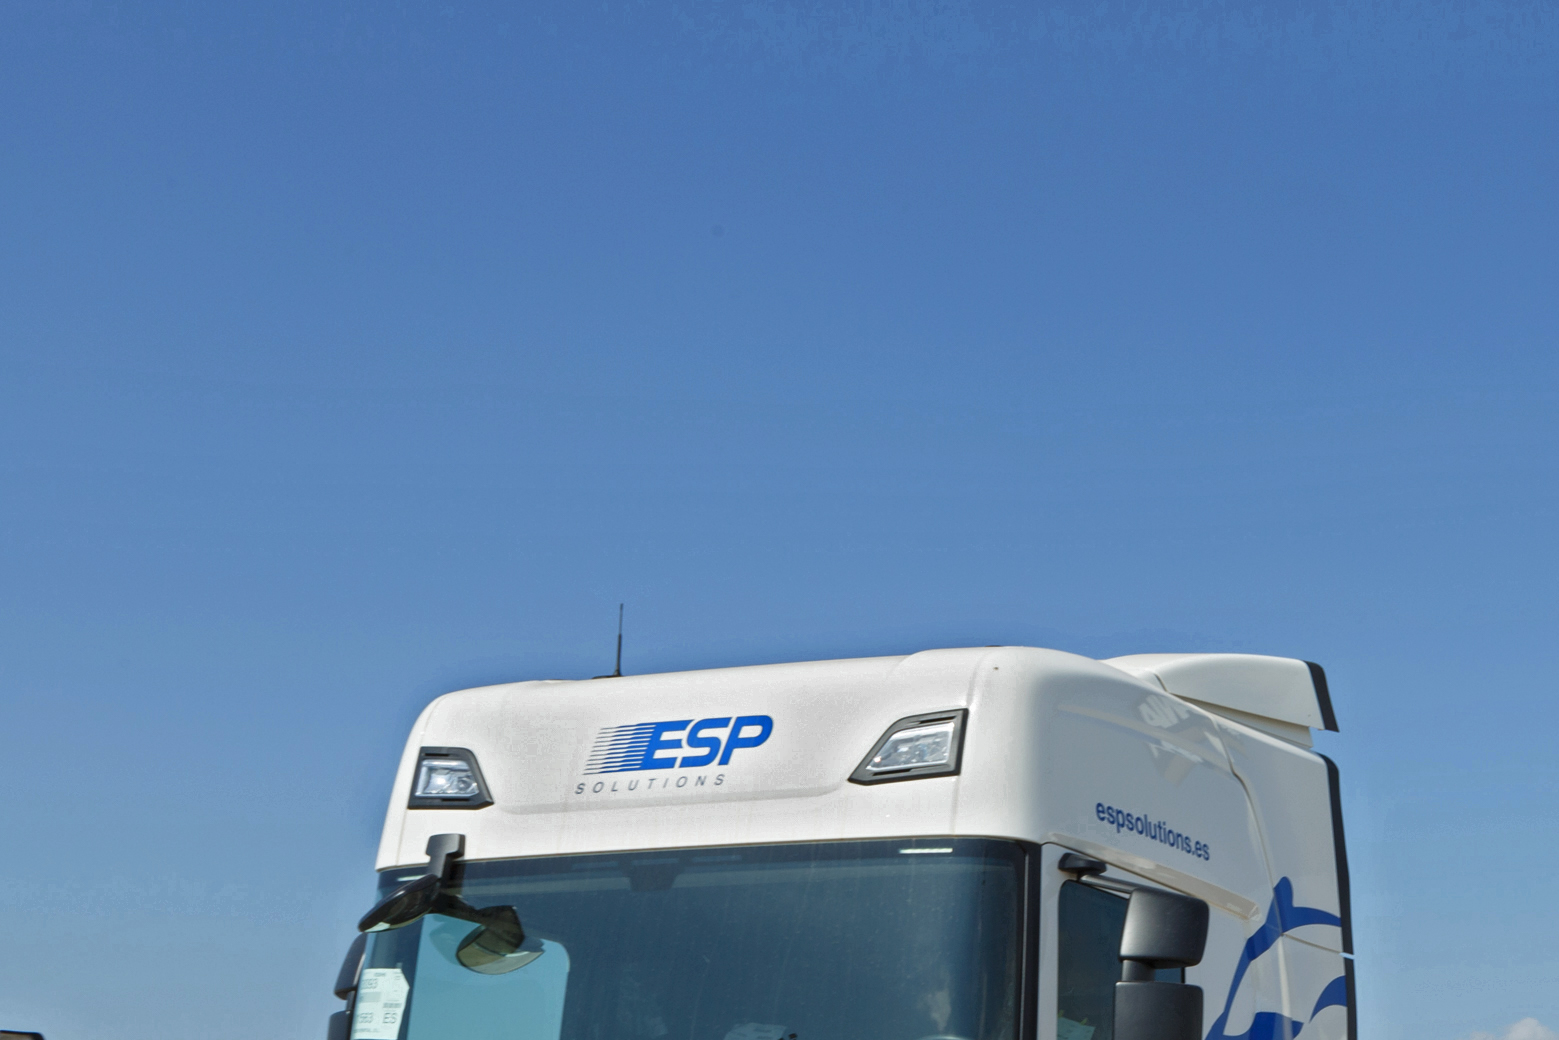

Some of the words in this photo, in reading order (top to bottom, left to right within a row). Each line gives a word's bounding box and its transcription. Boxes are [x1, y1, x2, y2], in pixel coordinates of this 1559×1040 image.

[618, 715, 774, 774] ESP
[574, 773, 726, 795] SOLUTIONS
[1096, 802, 1211, 861] espsolutions.es
